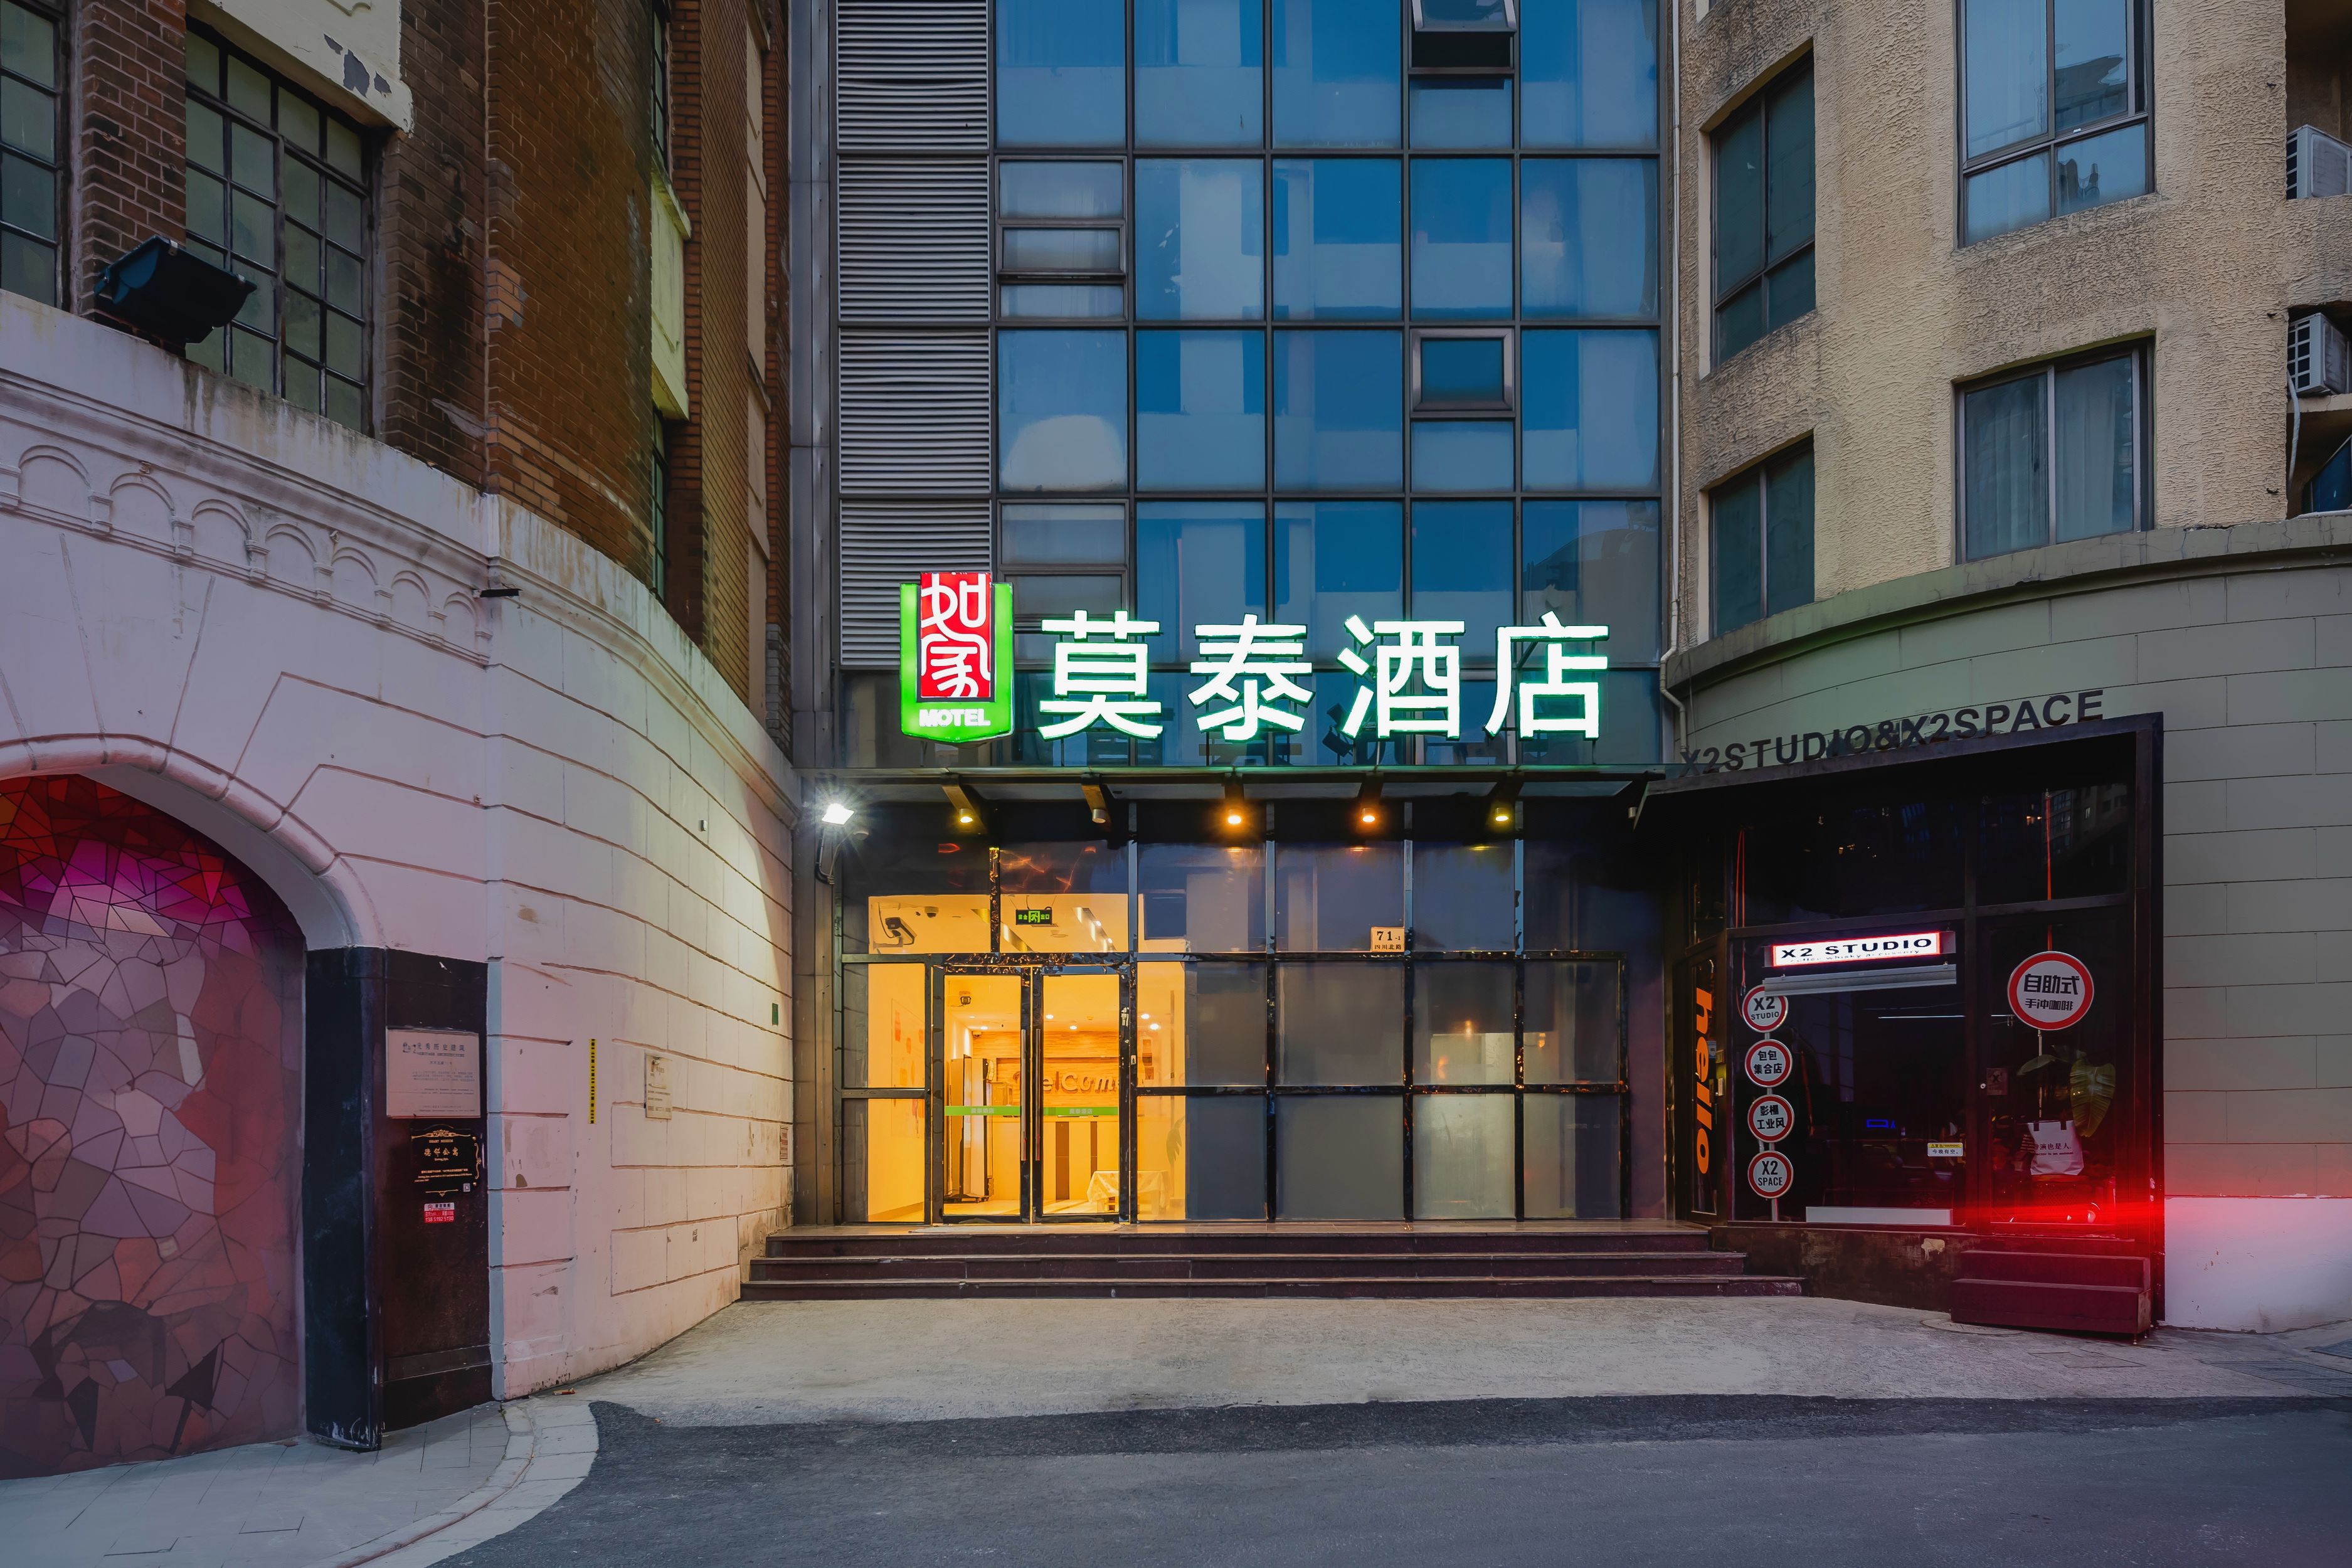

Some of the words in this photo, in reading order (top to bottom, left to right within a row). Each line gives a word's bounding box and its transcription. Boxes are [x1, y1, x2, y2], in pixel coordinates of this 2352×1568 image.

[921, 573, 991, 698] 如家
[1037, 610, 1611, 742] 莫泰酒店
[919, 708, 991, 728] MOTEL
[1781, 948, 1813, 959] X2
[1825, 938, 1932, 955] STUDIO
[2023, 973, 2080, 995] 自助式
[1753, 996, 1776, 1012] X2
[2025, 998, 2074, 1011] 手冲咖啡
[1751, 1011, 1780, 1020] STUDIO
[1757, 1050, 1777, 1061] 包包
[1753, 1063, 1783, 1074] 集合店
[1696, 987, 1712, 1175] hello
[1761, 1160, 1778, 1175] X2
[1757, 1177, 1783, 1186] SPACE
